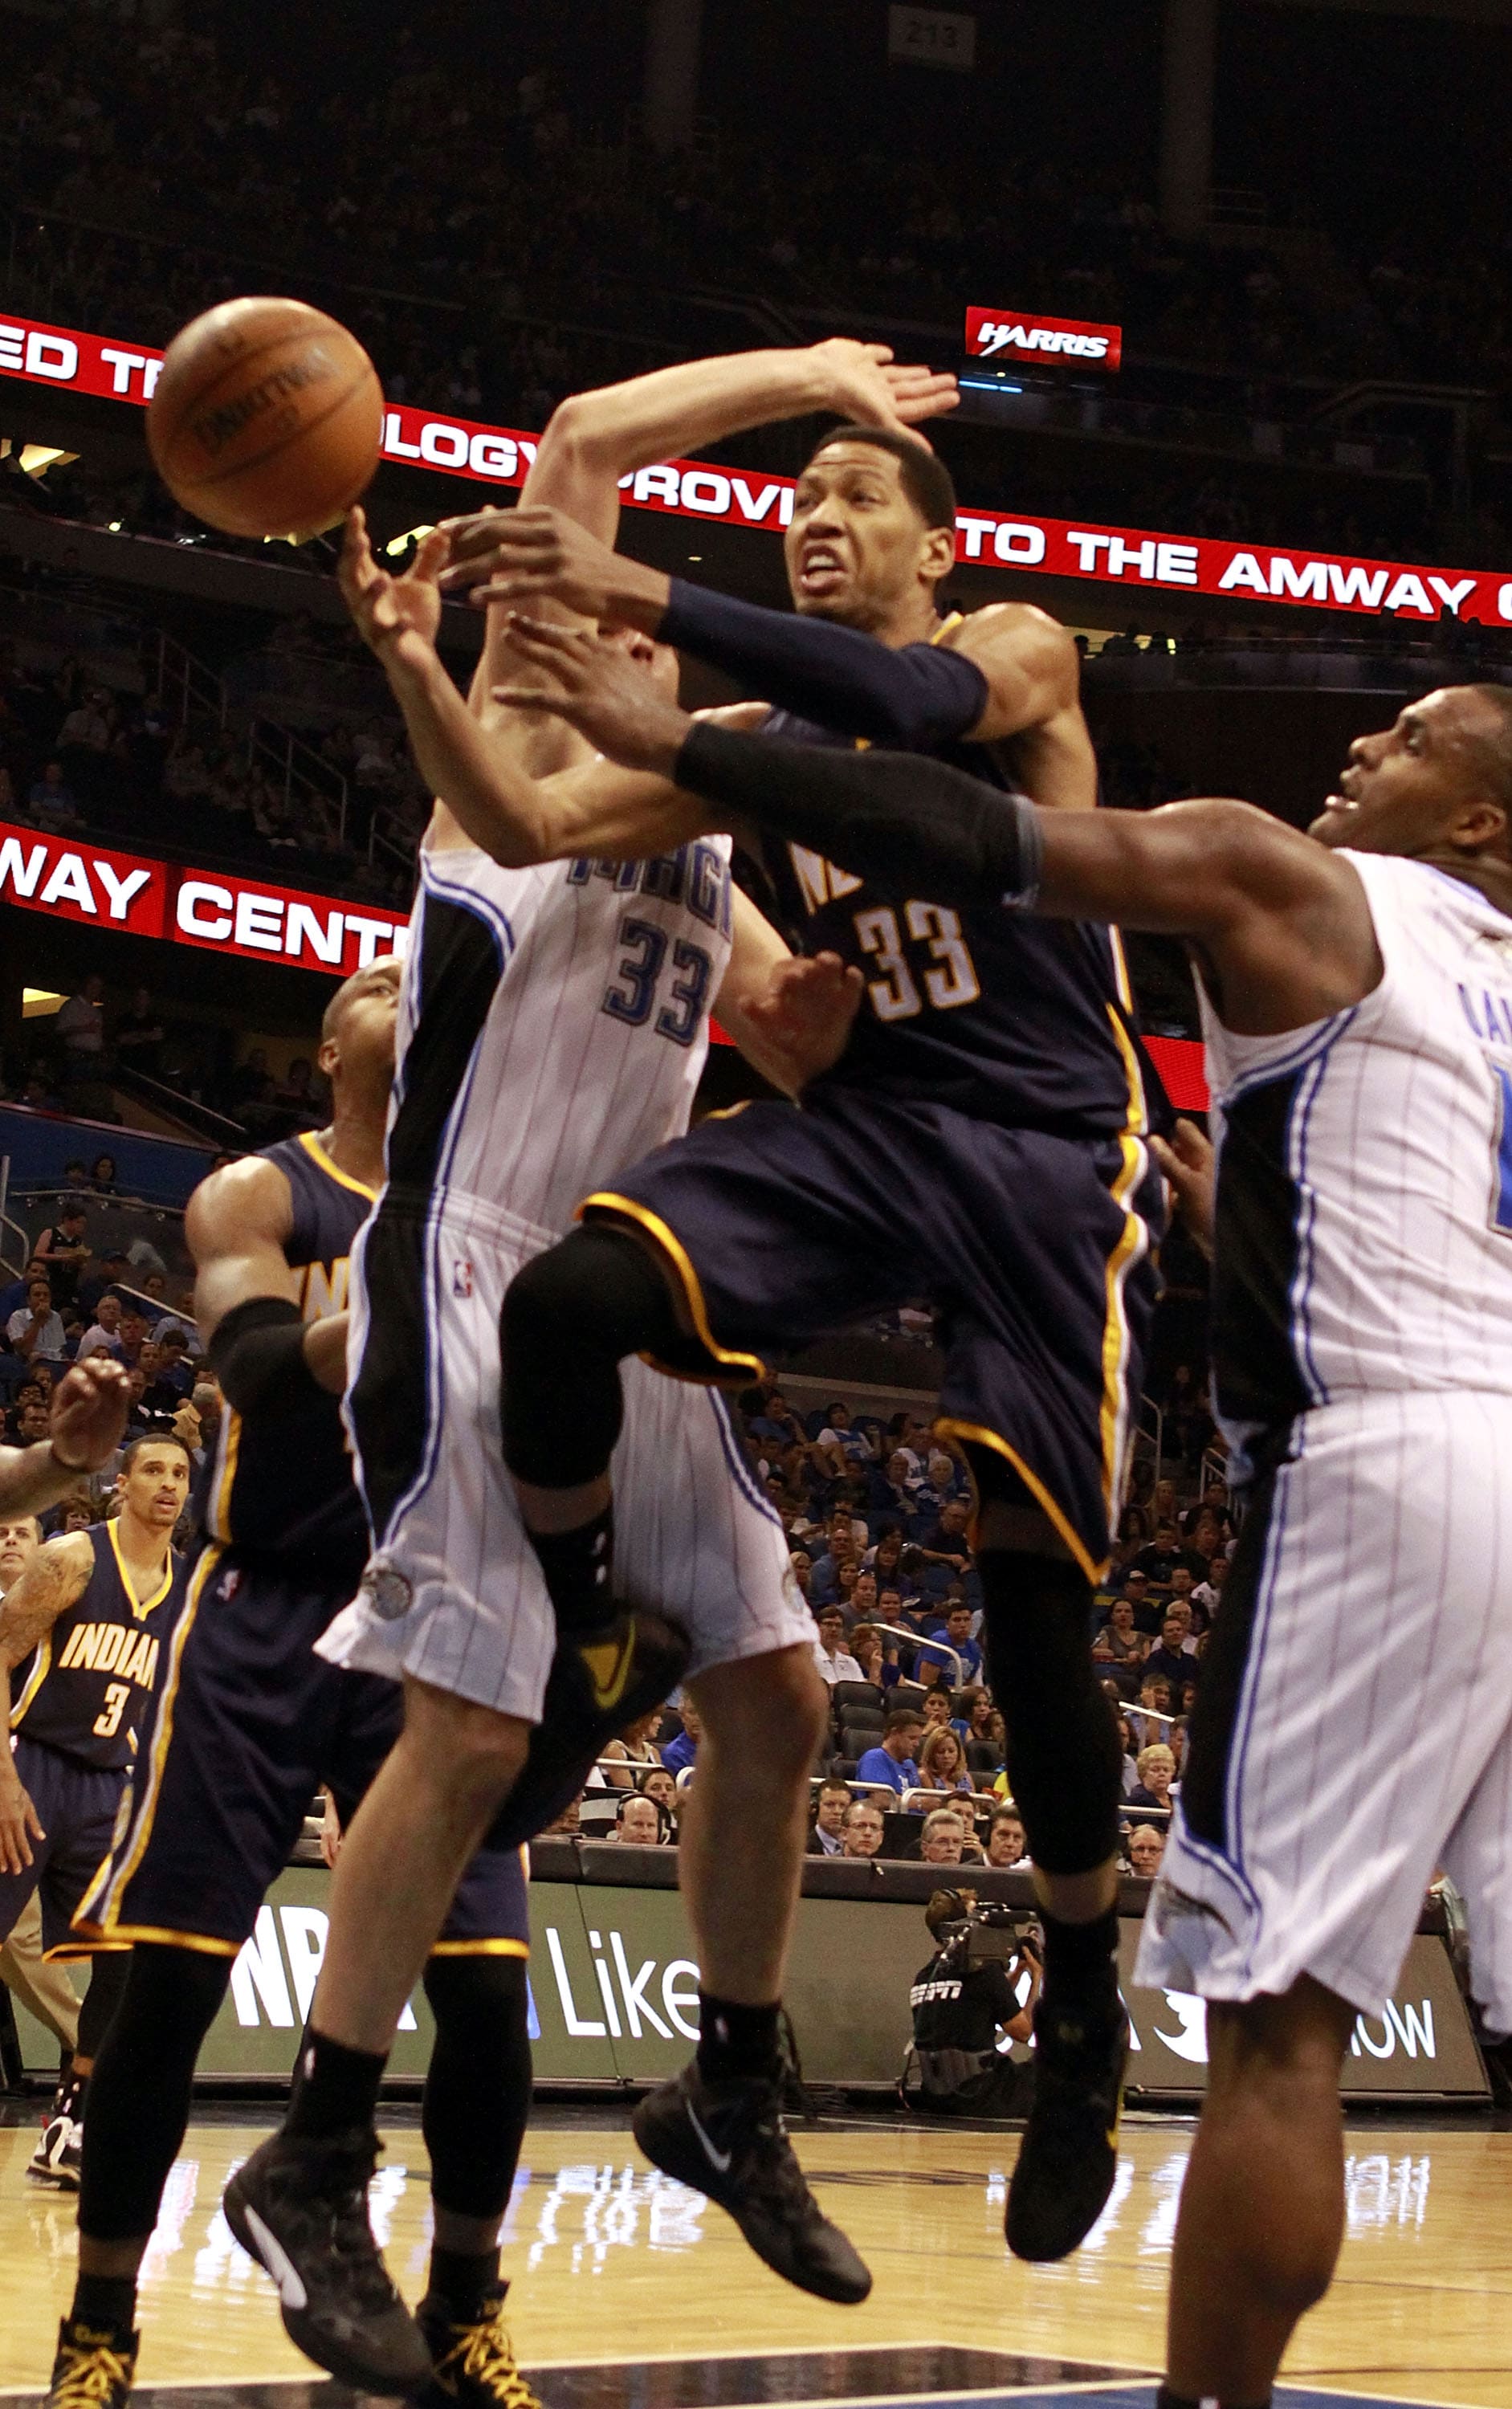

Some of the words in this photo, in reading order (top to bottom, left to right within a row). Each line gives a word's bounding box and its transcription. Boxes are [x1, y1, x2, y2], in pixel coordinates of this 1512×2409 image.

[977, 322, 1110, 357] HARRIS
[379, 414, 541, 479] LOG
[617, 464, 795, 526] ROVI
[956, 516, 1046, 565] TO
[1067, 530, 1199, 585] THE
[1218, 552, 1477, 615] AMWAY
[601, 916, 713, 1047] 33
[852, 897, 981, 1022] 33
[92, 1681, 131, 1738] 3
[910, 1979, 963, 2007] ESPN
